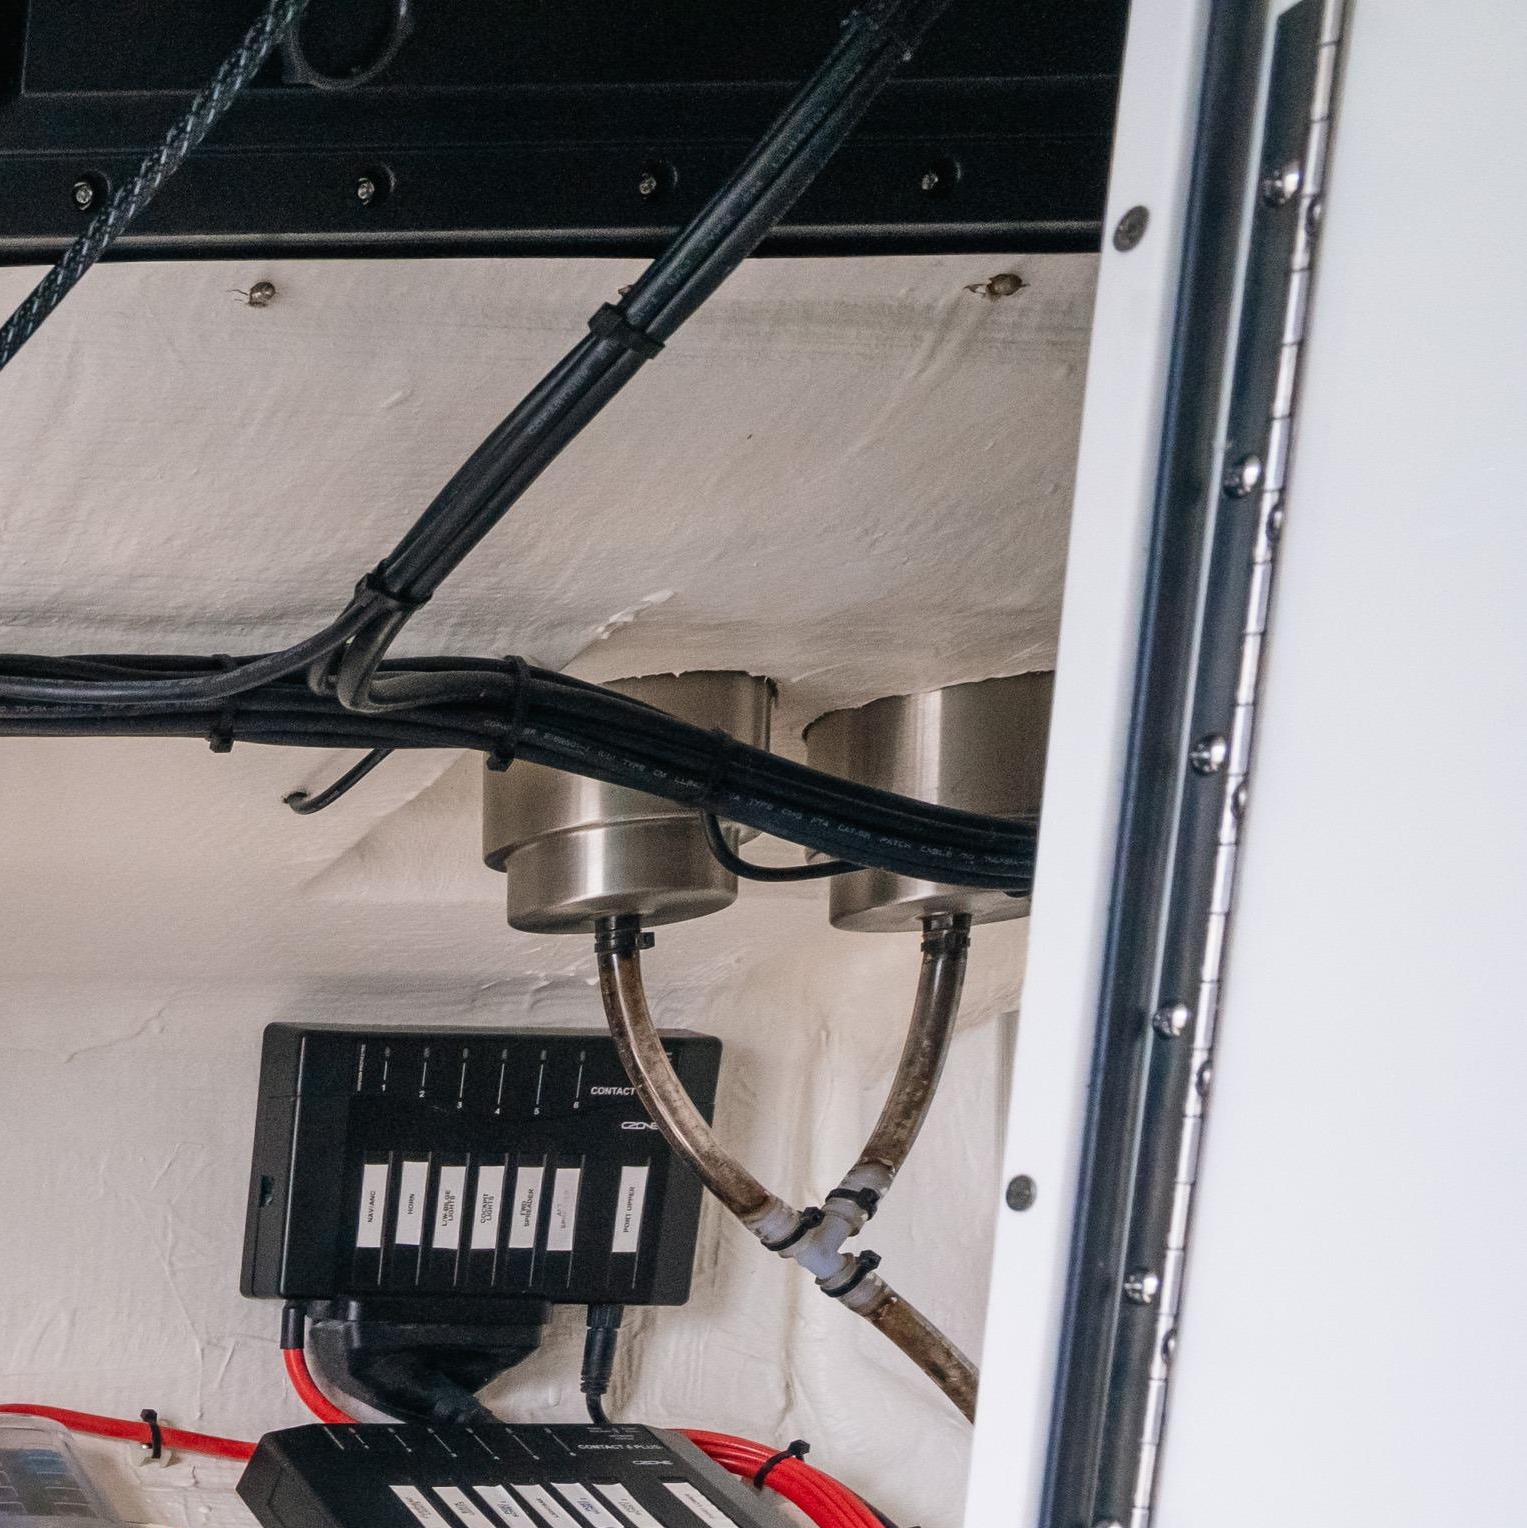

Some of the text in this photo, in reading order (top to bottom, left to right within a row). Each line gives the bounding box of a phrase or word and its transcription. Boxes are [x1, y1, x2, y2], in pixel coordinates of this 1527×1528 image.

[418, 1090, 425, 1098] 2
[590, 1086, 636, 1096] CONTACT
[457, 1101, 463, 1109] 3
[573, 1101, 580, 1109] 6
[494, 1107, 501, 1115] 4
[533, 1107, 540, 1115] 5
[406, 1193, 415, 1214] HORN
[481, 1193, 489, 1223] COCKPIT
[487, 1195, 495, 1220] LIGHTS
[623, 1186, 635, 1232] PORT UPPER
